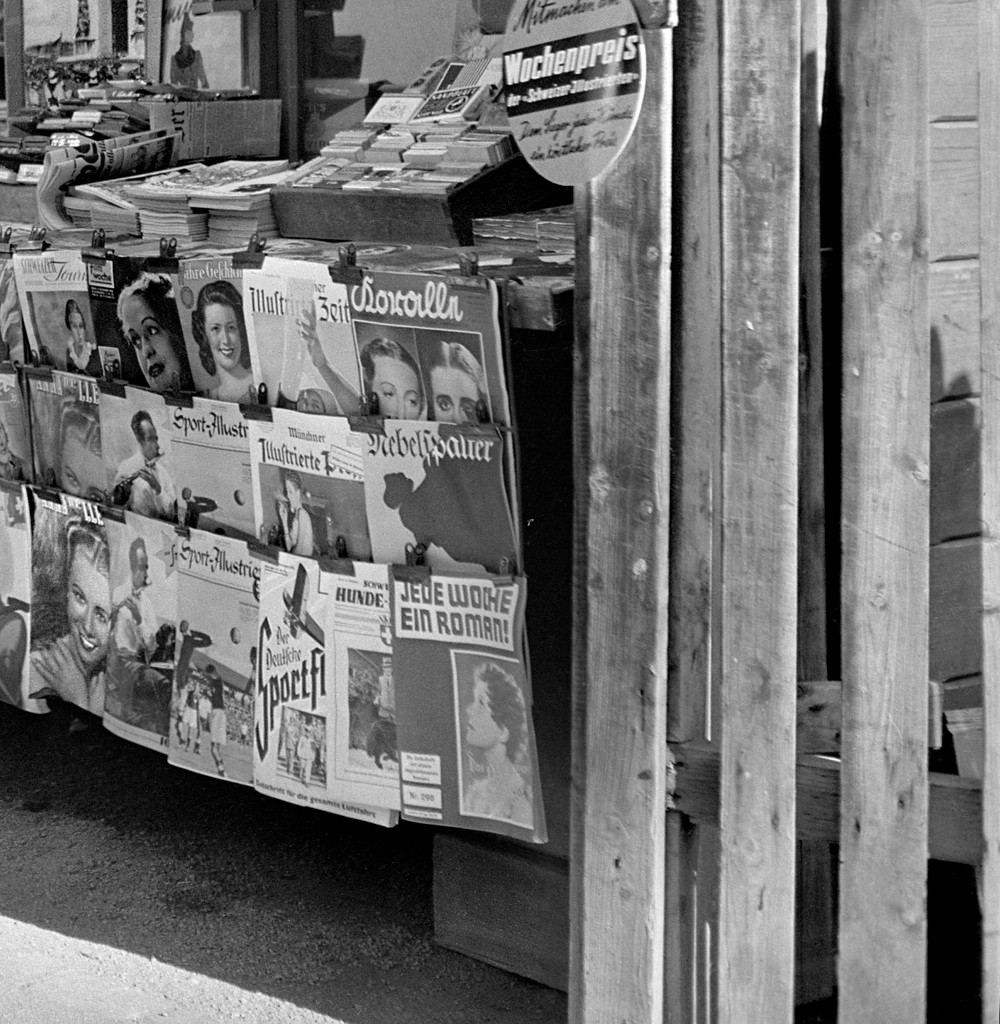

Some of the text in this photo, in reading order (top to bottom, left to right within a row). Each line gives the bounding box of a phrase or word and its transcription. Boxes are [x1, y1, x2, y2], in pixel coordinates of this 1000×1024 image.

[504, 27, 639, 85] Wochenpreis
[507, 93, 521, 107] der
[21, 257, 57, 274] SCHWEIZER
[288, 426, 327, 444] Münchner
[258, 438, 321, 472] Illustrierte
[335, 586, 388, 609] HUNDE-
[400, 580, 514, 615] JEDE WOCHE
[276, 625, 290, 645] Der
[400, 606, 433, 633] EIN
[436, 610, 510, 645] ROMAN!
[266, 647, 302, 671] Deutsche
[286, 788, 296, 798] für
[297, 792, 309, 802] die
